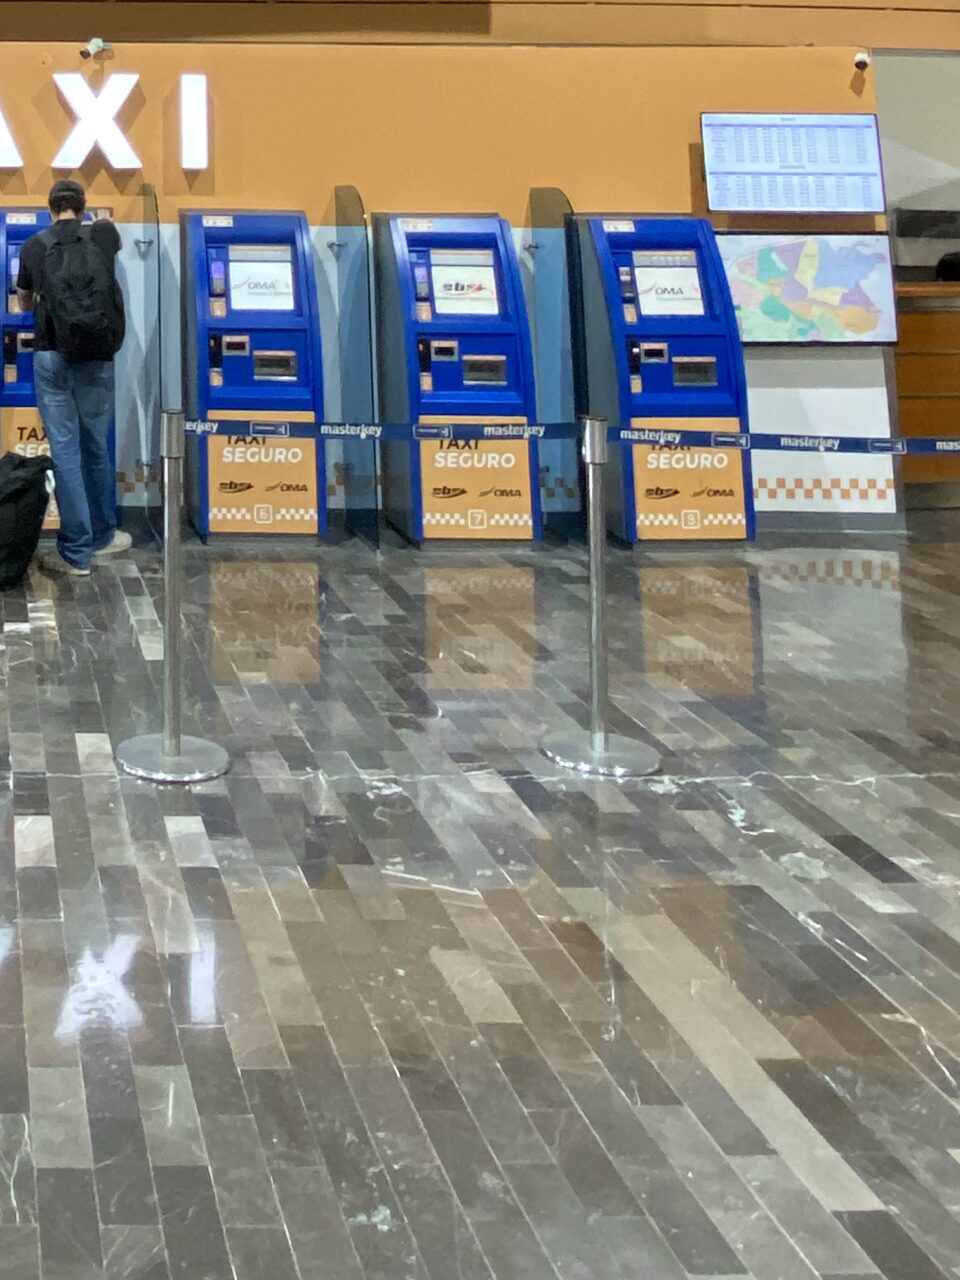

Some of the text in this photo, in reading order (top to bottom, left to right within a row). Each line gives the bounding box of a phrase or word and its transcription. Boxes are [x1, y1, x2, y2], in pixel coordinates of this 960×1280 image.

[248, 280, 276, 290] OMA
[655, 287, 684, 296] OMA
[321, 423, 382, 439] masterkey
[484, 425, 545, 438] masterkey
[620, 429, 681, 444] masterkey
[781, 436, 840, 452] masterkey
[222, 447, 302, 463] SEGURO
[434, 452, 516, 468] SEGURO
[646, 453, 729, 469] SEGURO
[280, 483, 308, 492] OMA
[473, 514, 482, 526] 7
